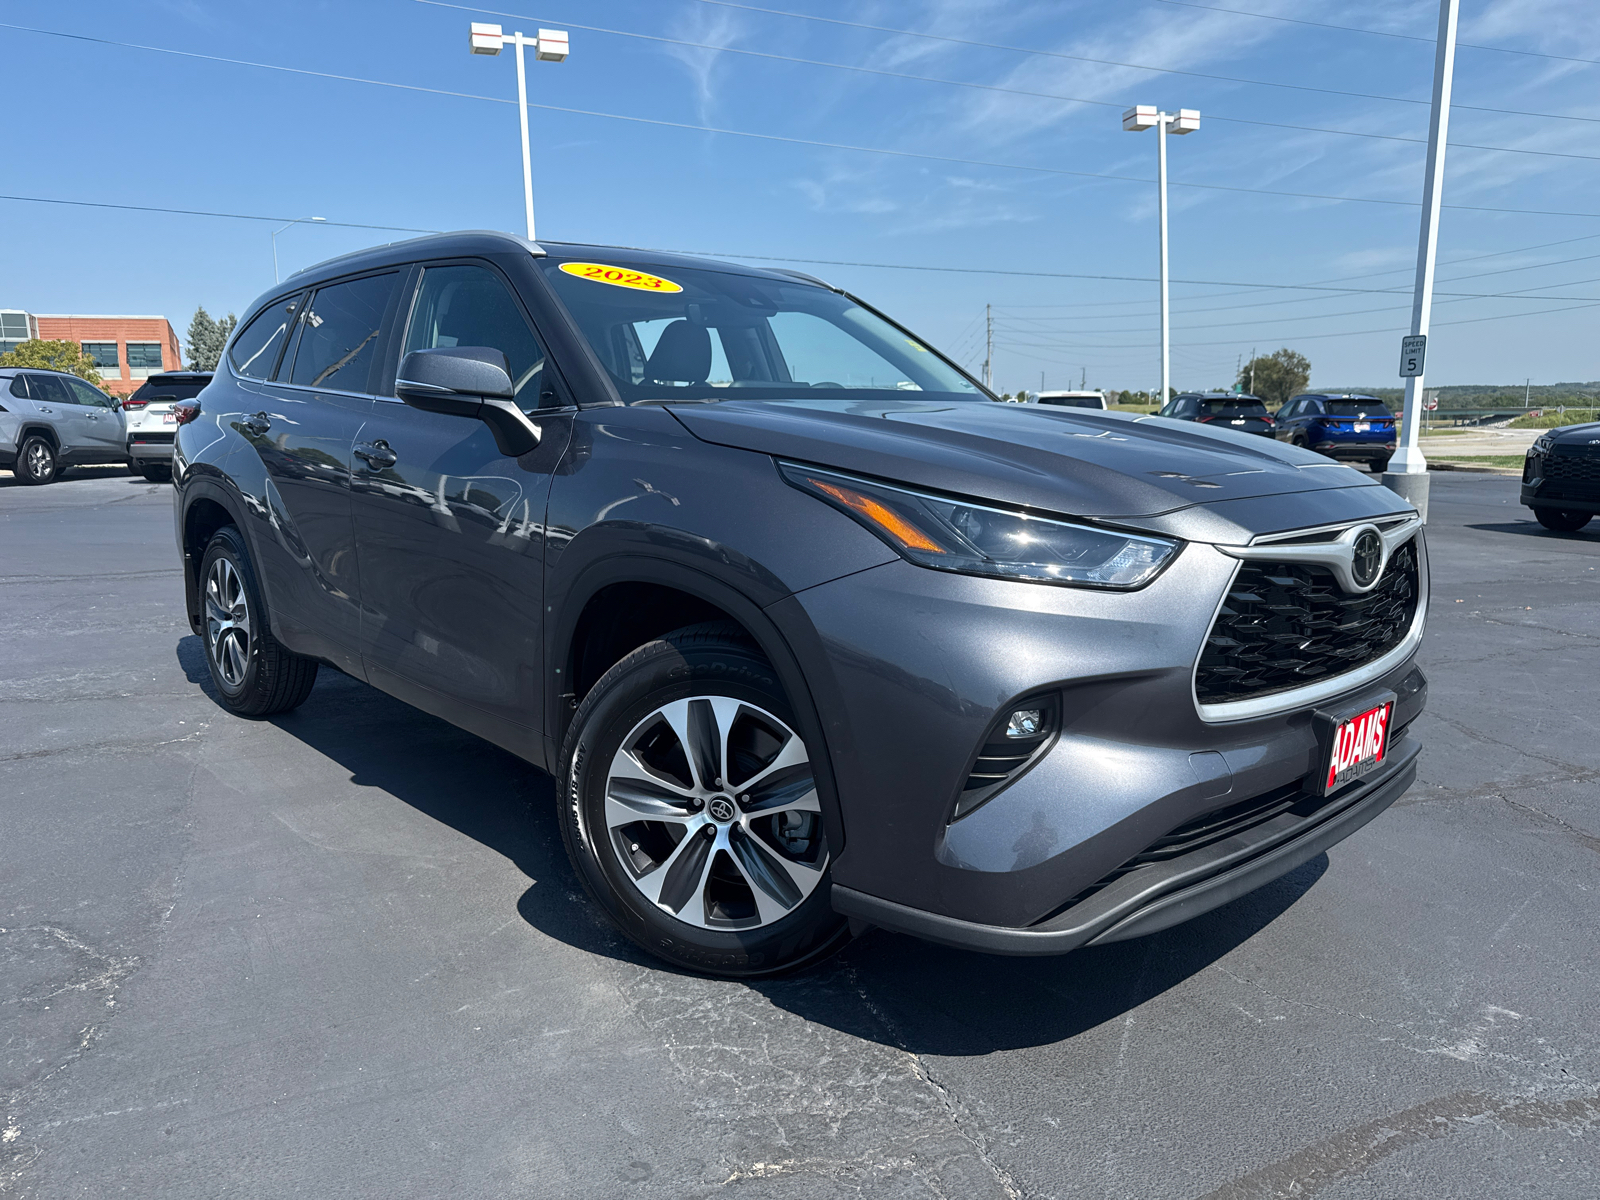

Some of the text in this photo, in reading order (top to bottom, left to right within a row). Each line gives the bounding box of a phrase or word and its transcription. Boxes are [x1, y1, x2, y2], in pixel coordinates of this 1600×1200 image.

[583, 267, 662, 288] 2023
[1404, 340, 1424, 348] SPEED
[1407, 358, 1417, 371] 5
[1331, 708, 1387, 775] ADAMS
